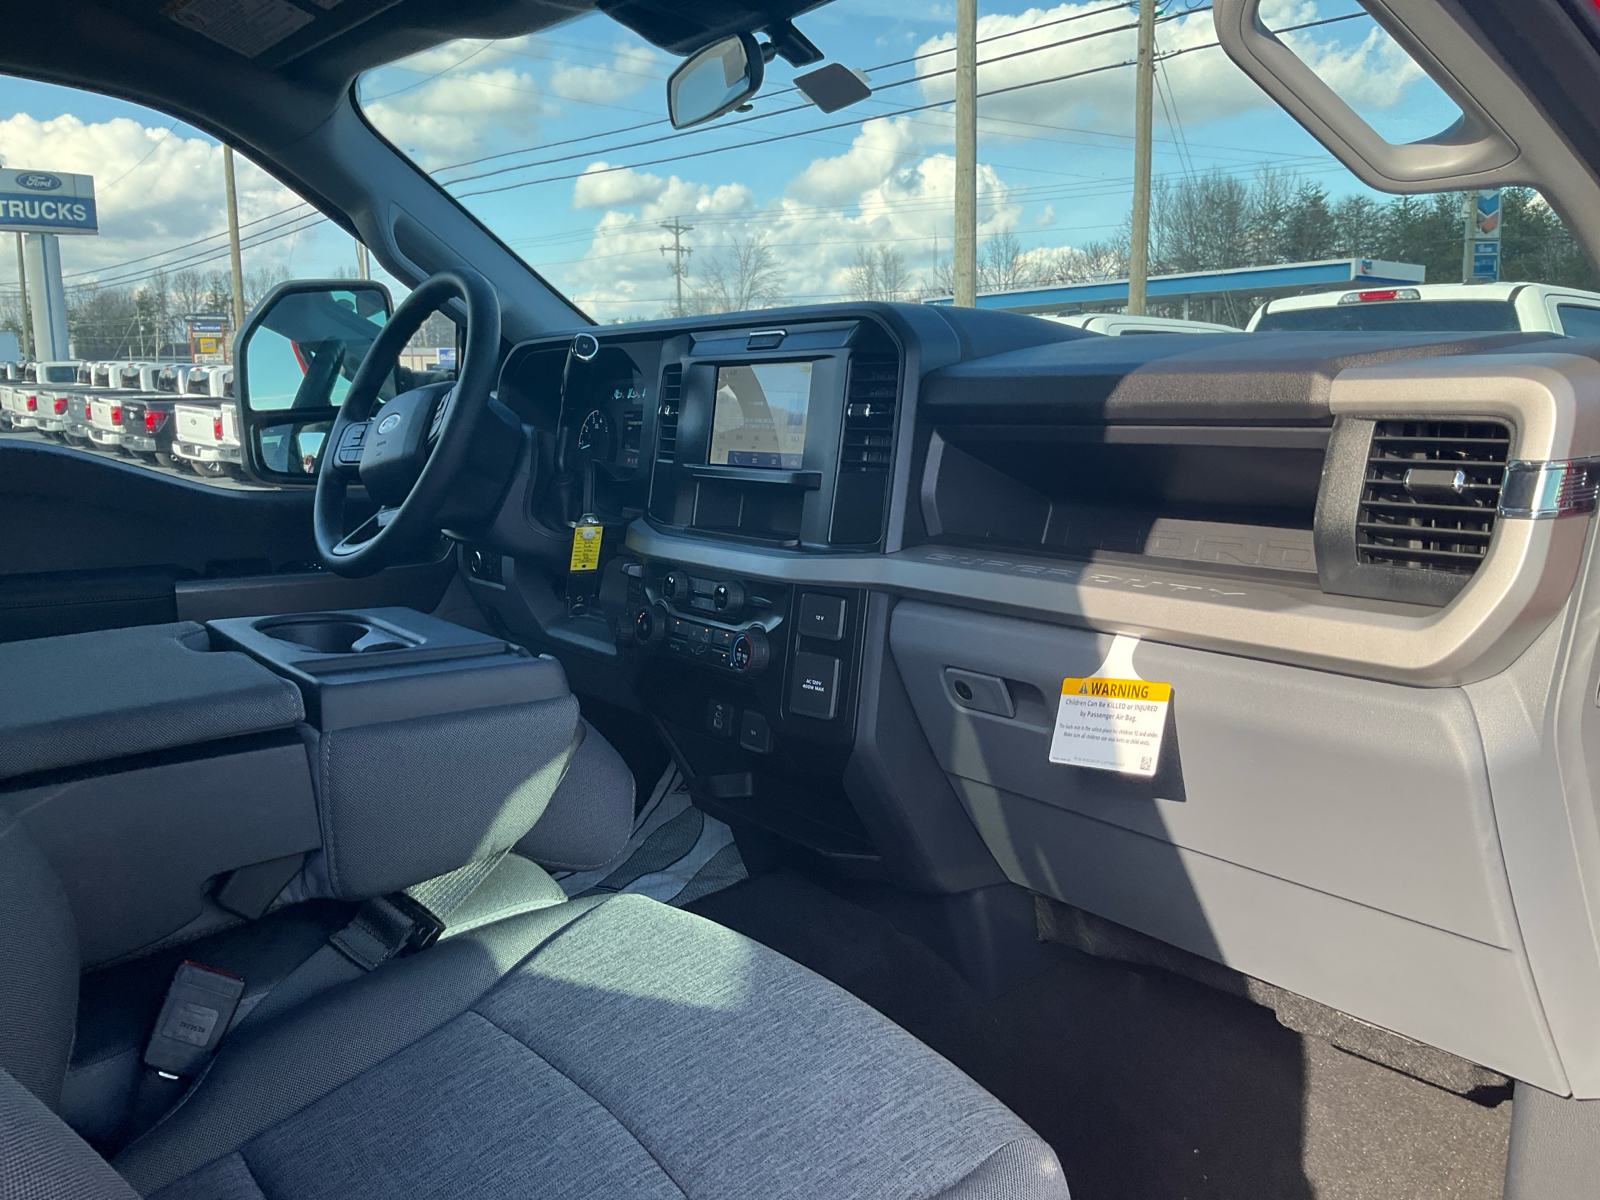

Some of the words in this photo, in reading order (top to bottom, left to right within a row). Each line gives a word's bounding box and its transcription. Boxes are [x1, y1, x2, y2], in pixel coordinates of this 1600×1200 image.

[26, 175, 52, 187] Ford
[0, 200, 87, 222] TRUCKS
[924, 553, 1078, 578] SUPER
[1085, 573, 1246, 598] DUTY
[1091, 682, 1149, 699] WARNING
[1134, 704, 1158, 712] INJURED
[1080, 710, 1086, 718] by
[1087, 711, 1115, 721] Passenger
[1125, 715, 1137, 723] Bag.
